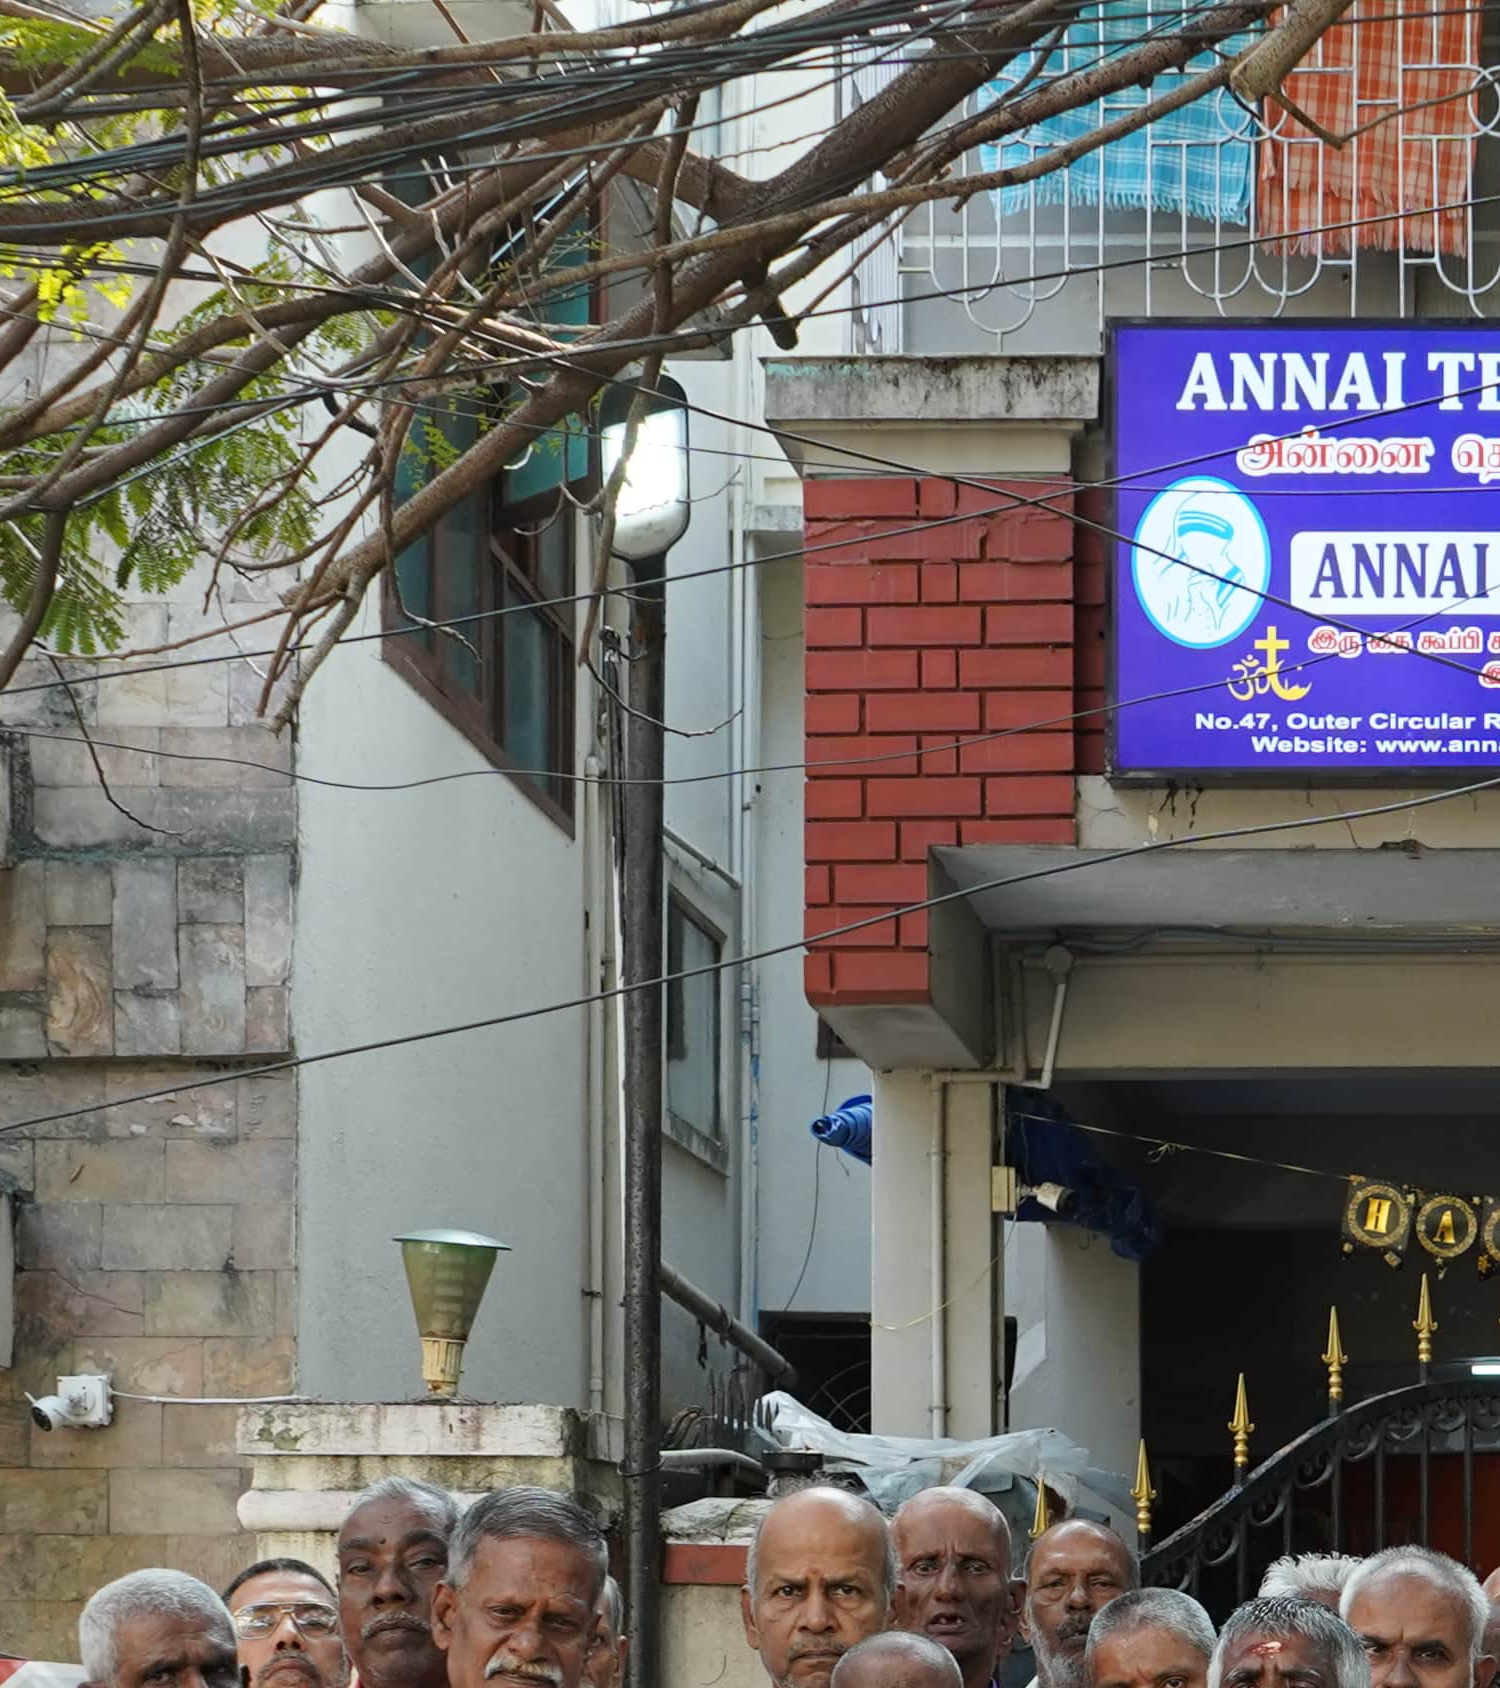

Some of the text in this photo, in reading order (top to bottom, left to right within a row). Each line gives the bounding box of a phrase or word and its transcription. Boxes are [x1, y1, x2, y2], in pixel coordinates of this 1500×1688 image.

[1177, 352, 1406, 411] ANNAI
[1240, 428, 1432, 474] அன்னை
[1311, 541, 1491, 600] ANNAI
[1195, 712, 1277, 733] No.47,
[1286, 711, 1362, 731] Outer
[1369, 711, 1476, 731] Circular
[1252, 736, 1368, 754] Website:
